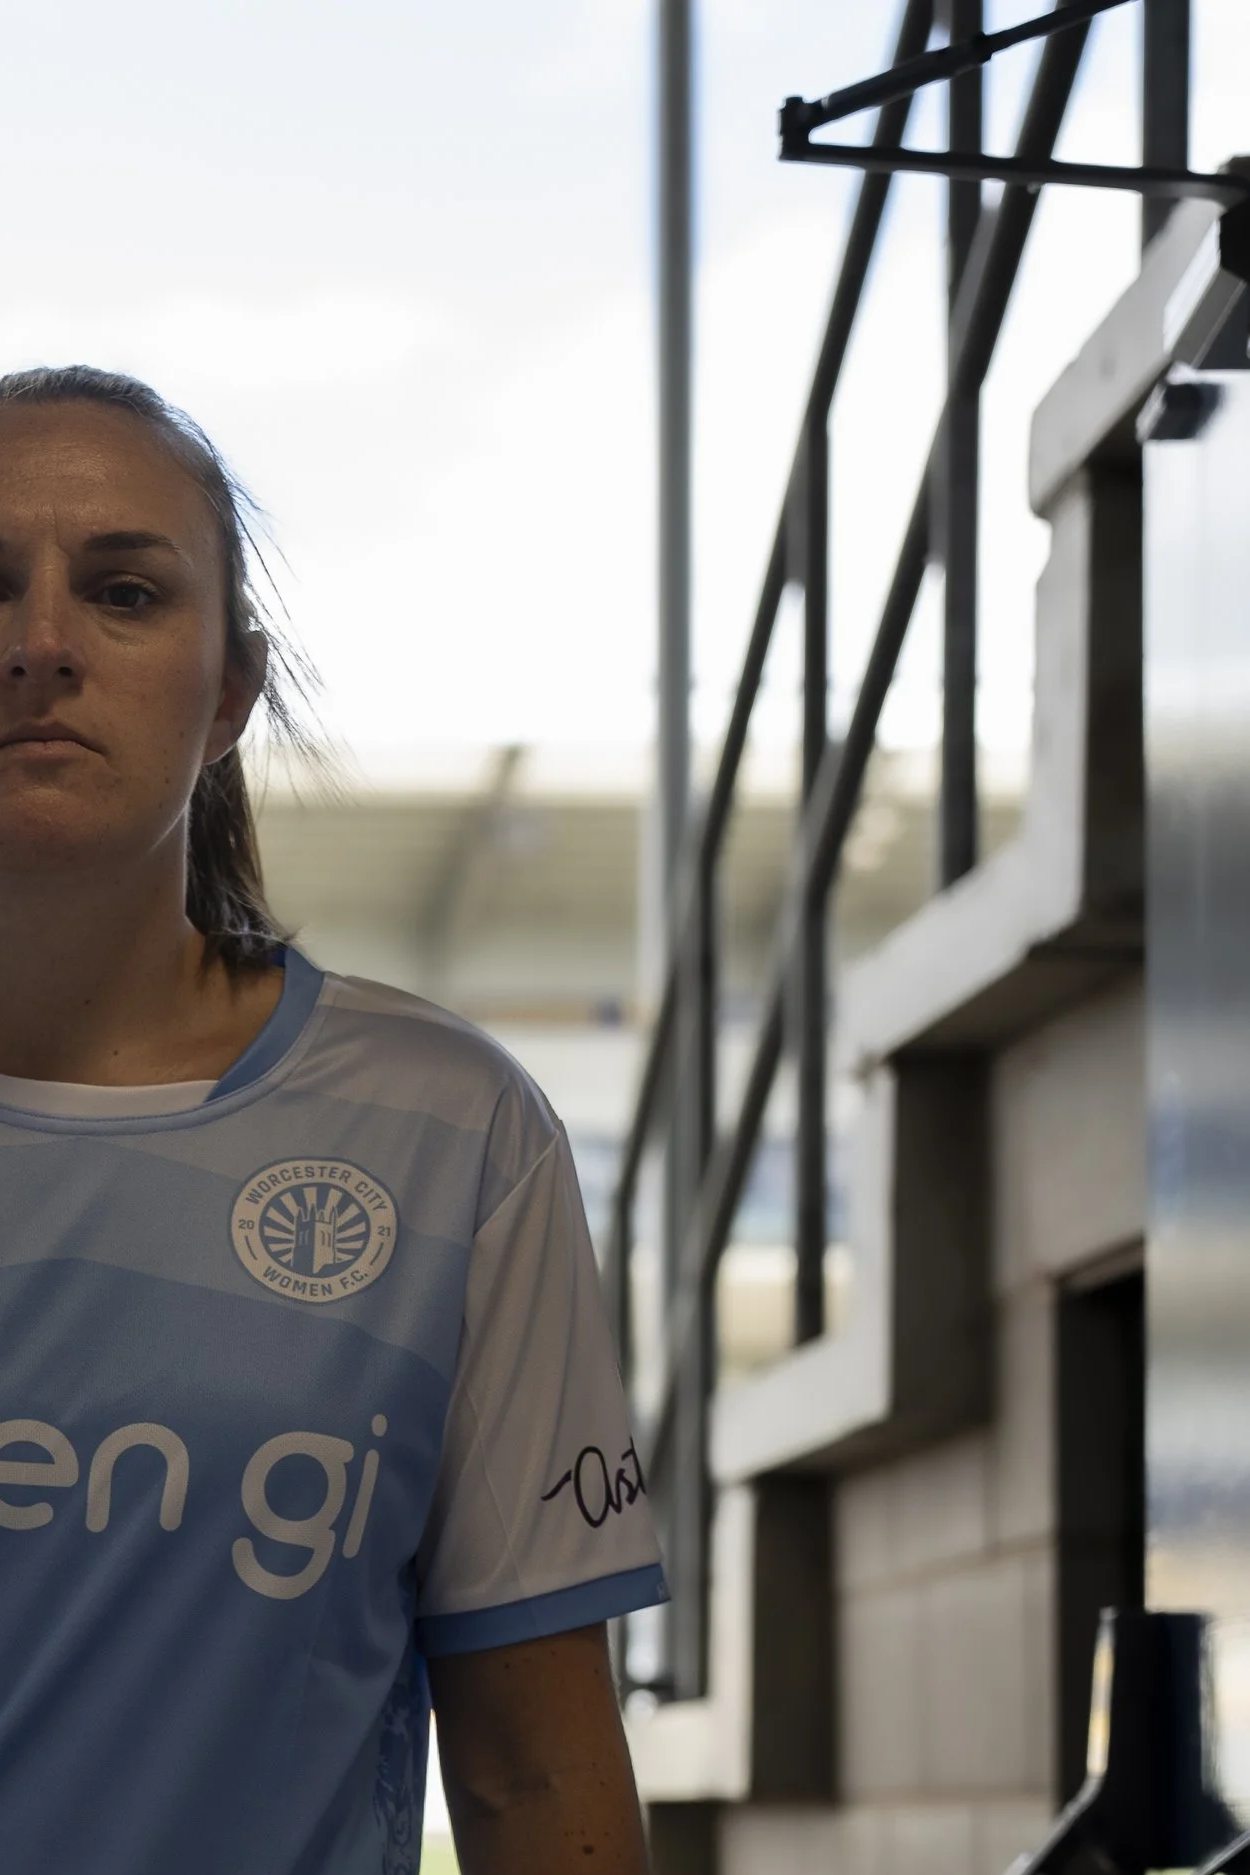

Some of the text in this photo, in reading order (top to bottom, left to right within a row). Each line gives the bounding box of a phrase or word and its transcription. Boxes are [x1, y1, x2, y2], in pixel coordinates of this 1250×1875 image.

[245, 1165, 388, 1212] WORCESTER CITY
[238, 1219, 255, 1230] 20
[377, 1226, 391, 1237] 21
[262, 1265, 369, 1297] WOMEN F.C.
[231, 1413, 389, 1600] gi
